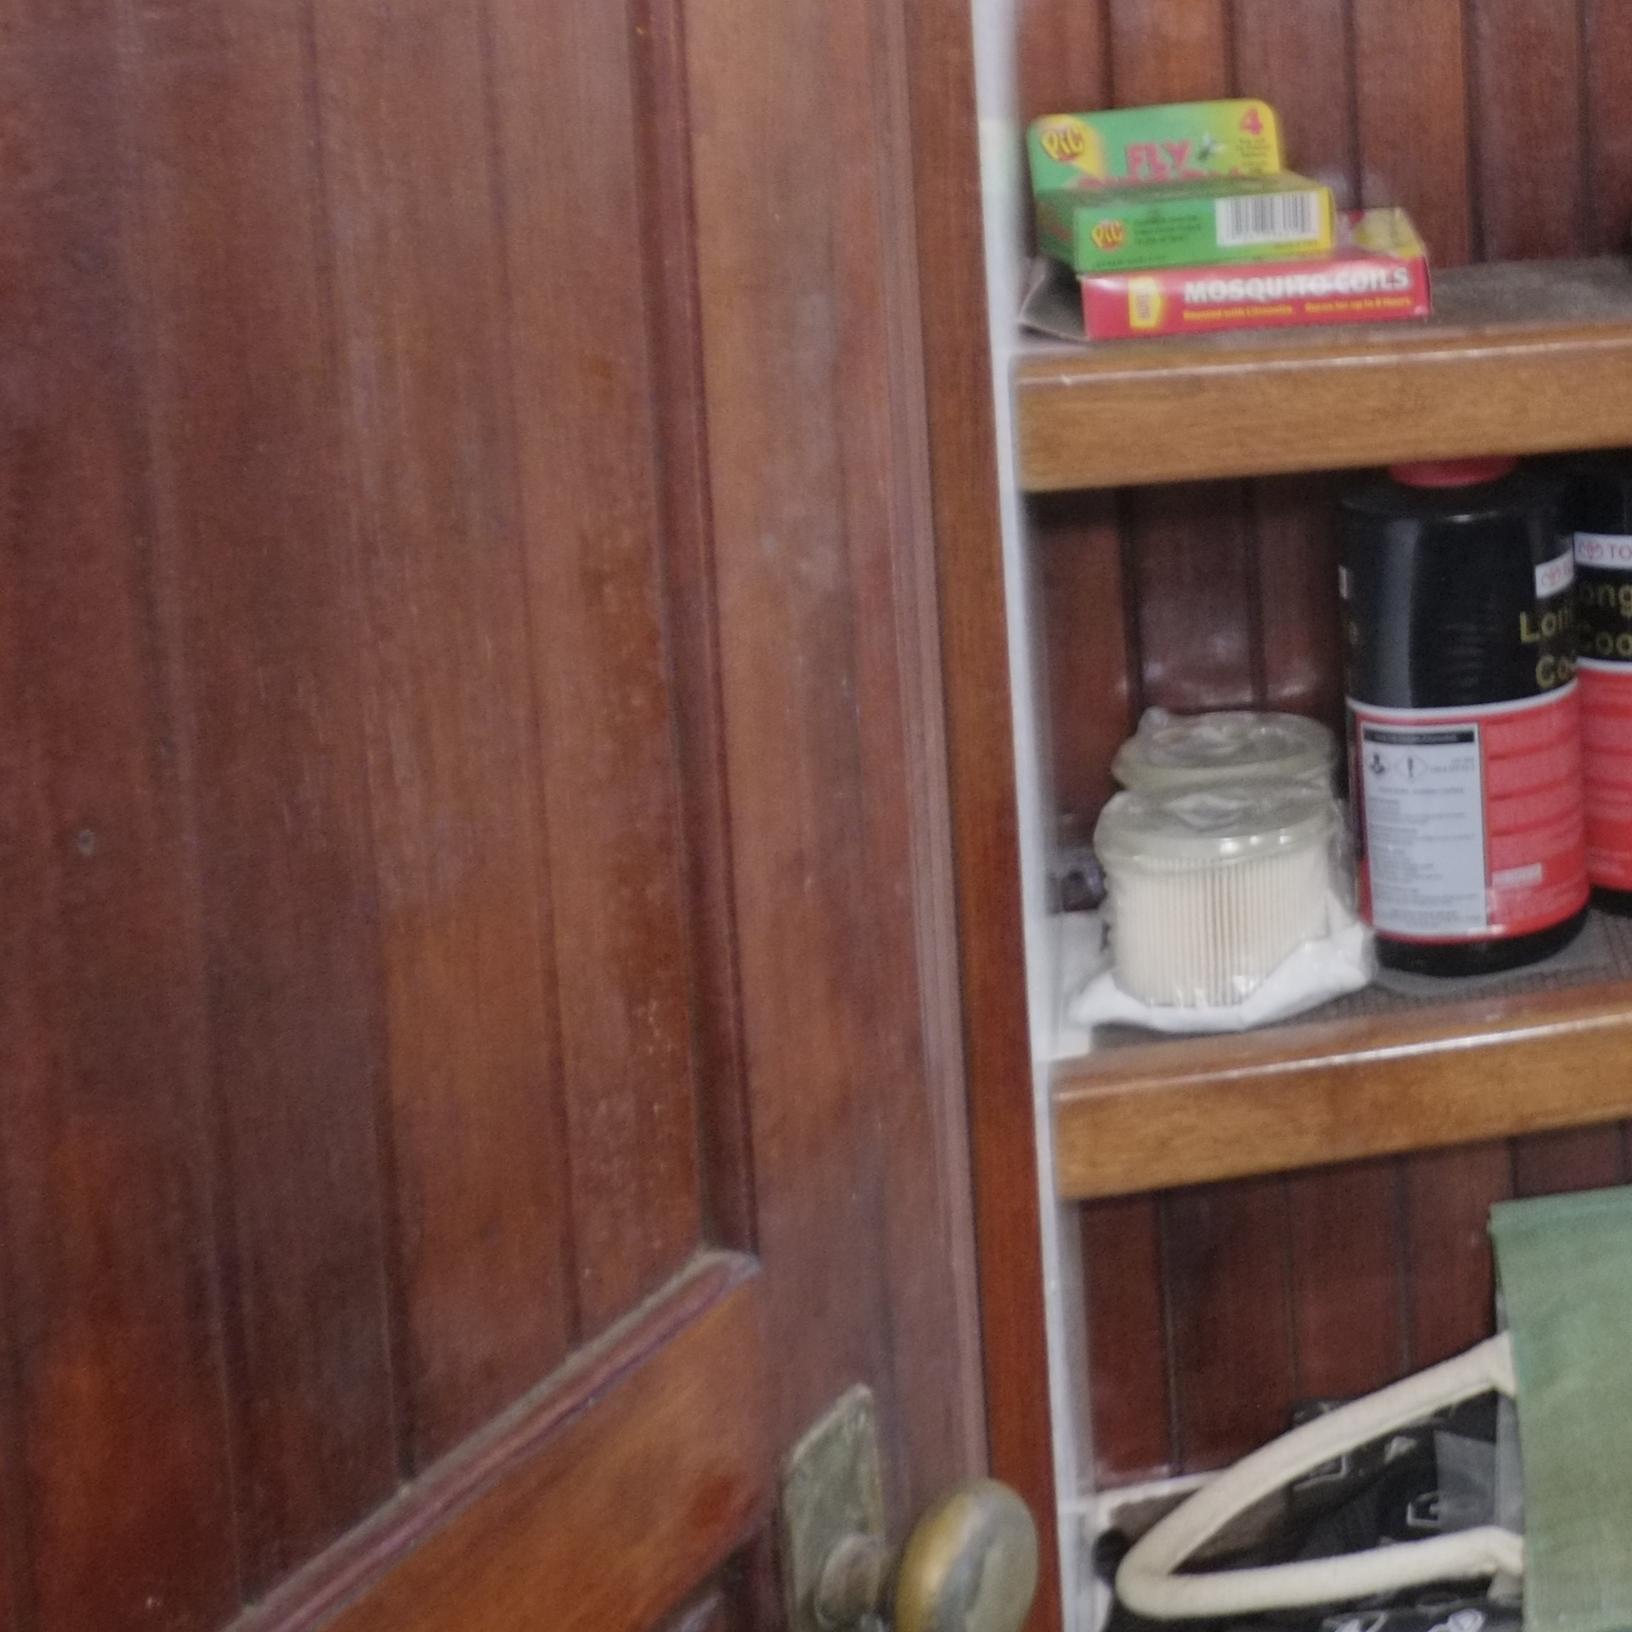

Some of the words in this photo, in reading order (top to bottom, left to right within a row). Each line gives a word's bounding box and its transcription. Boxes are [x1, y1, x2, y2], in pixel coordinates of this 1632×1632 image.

[1241, 108, 1263, 136] 4
[1126, 140, 1191, 172] FLY
[1184, 272, 1329, 304] MOSQUITO
[1334, 266, 1410, 294] COILS
